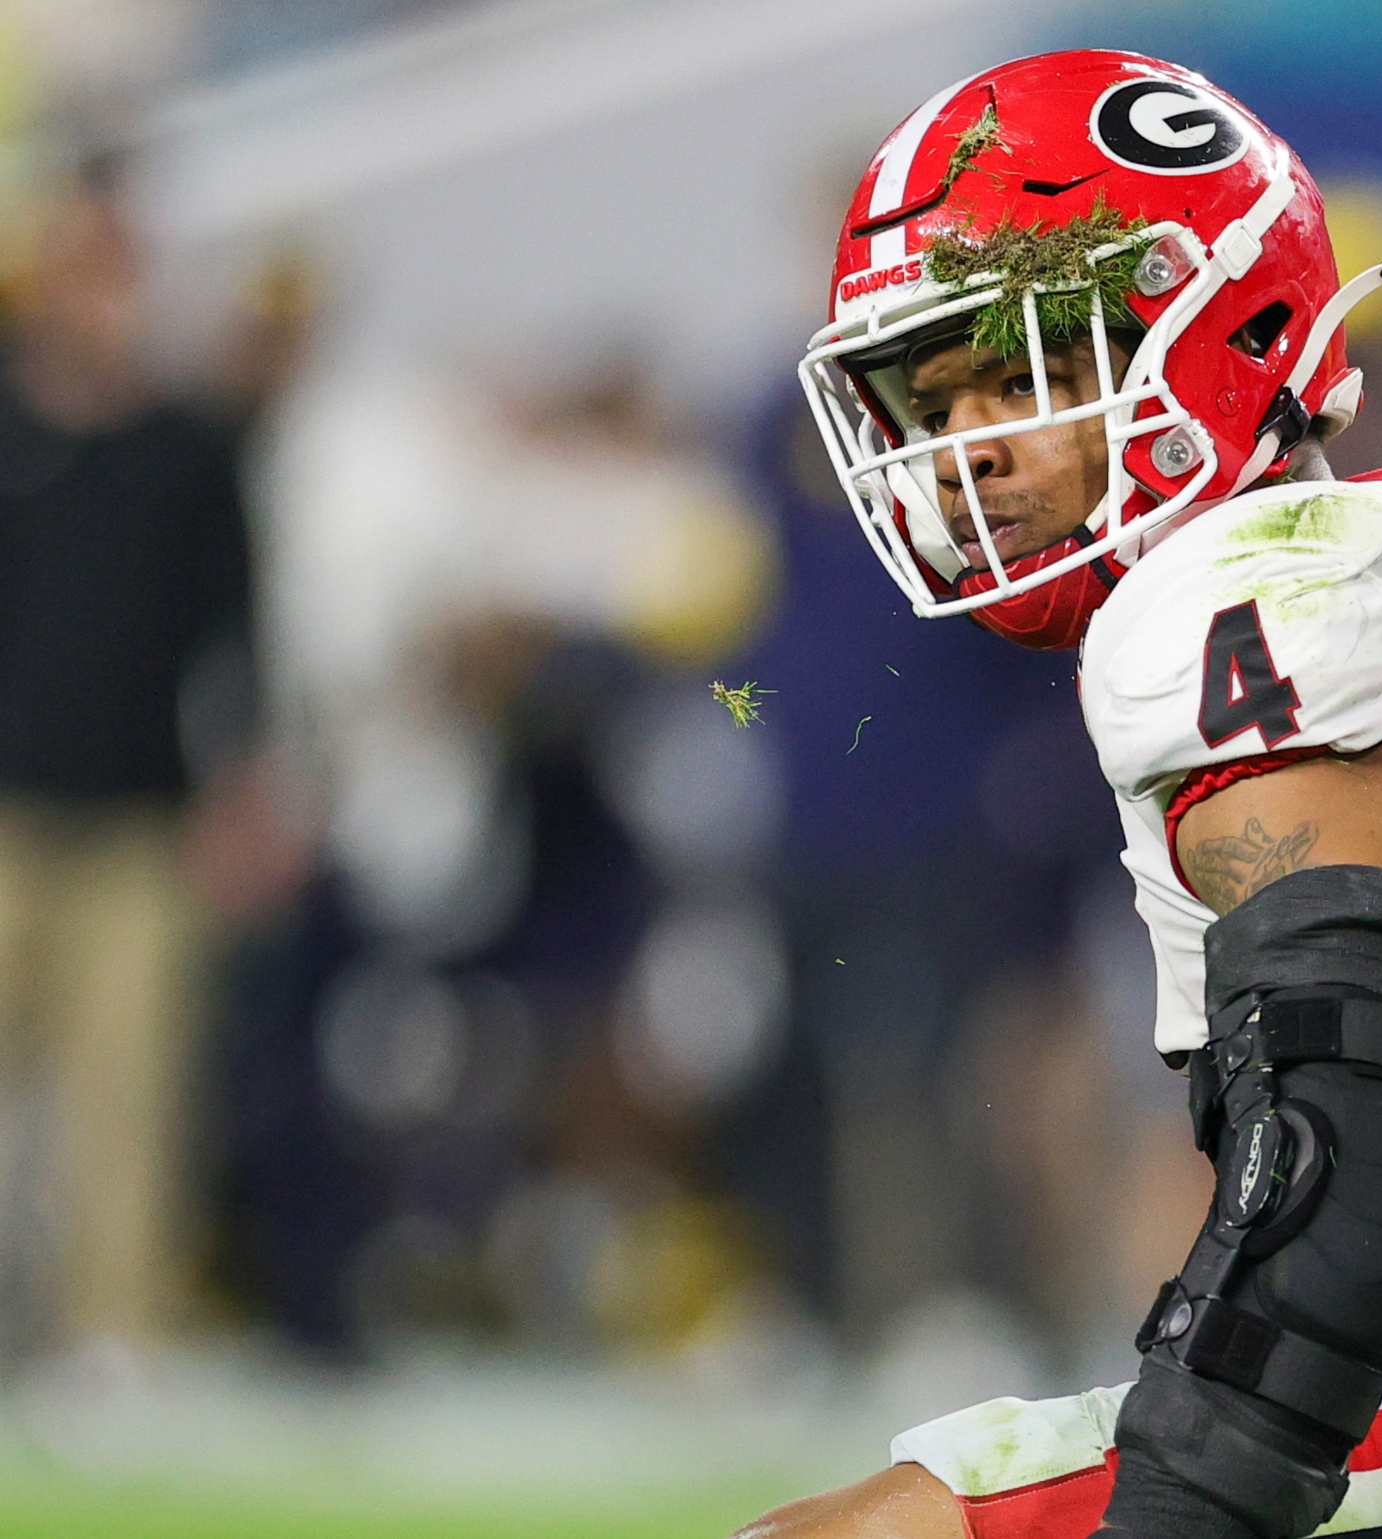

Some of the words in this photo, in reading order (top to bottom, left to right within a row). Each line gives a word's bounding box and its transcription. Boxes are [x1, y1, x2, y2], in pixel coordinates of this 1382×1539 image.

[1098, 80, 1245, 169] G
[840, 259, 922, 302] DAWGS
[1198, 599, 1302, 751] 4
